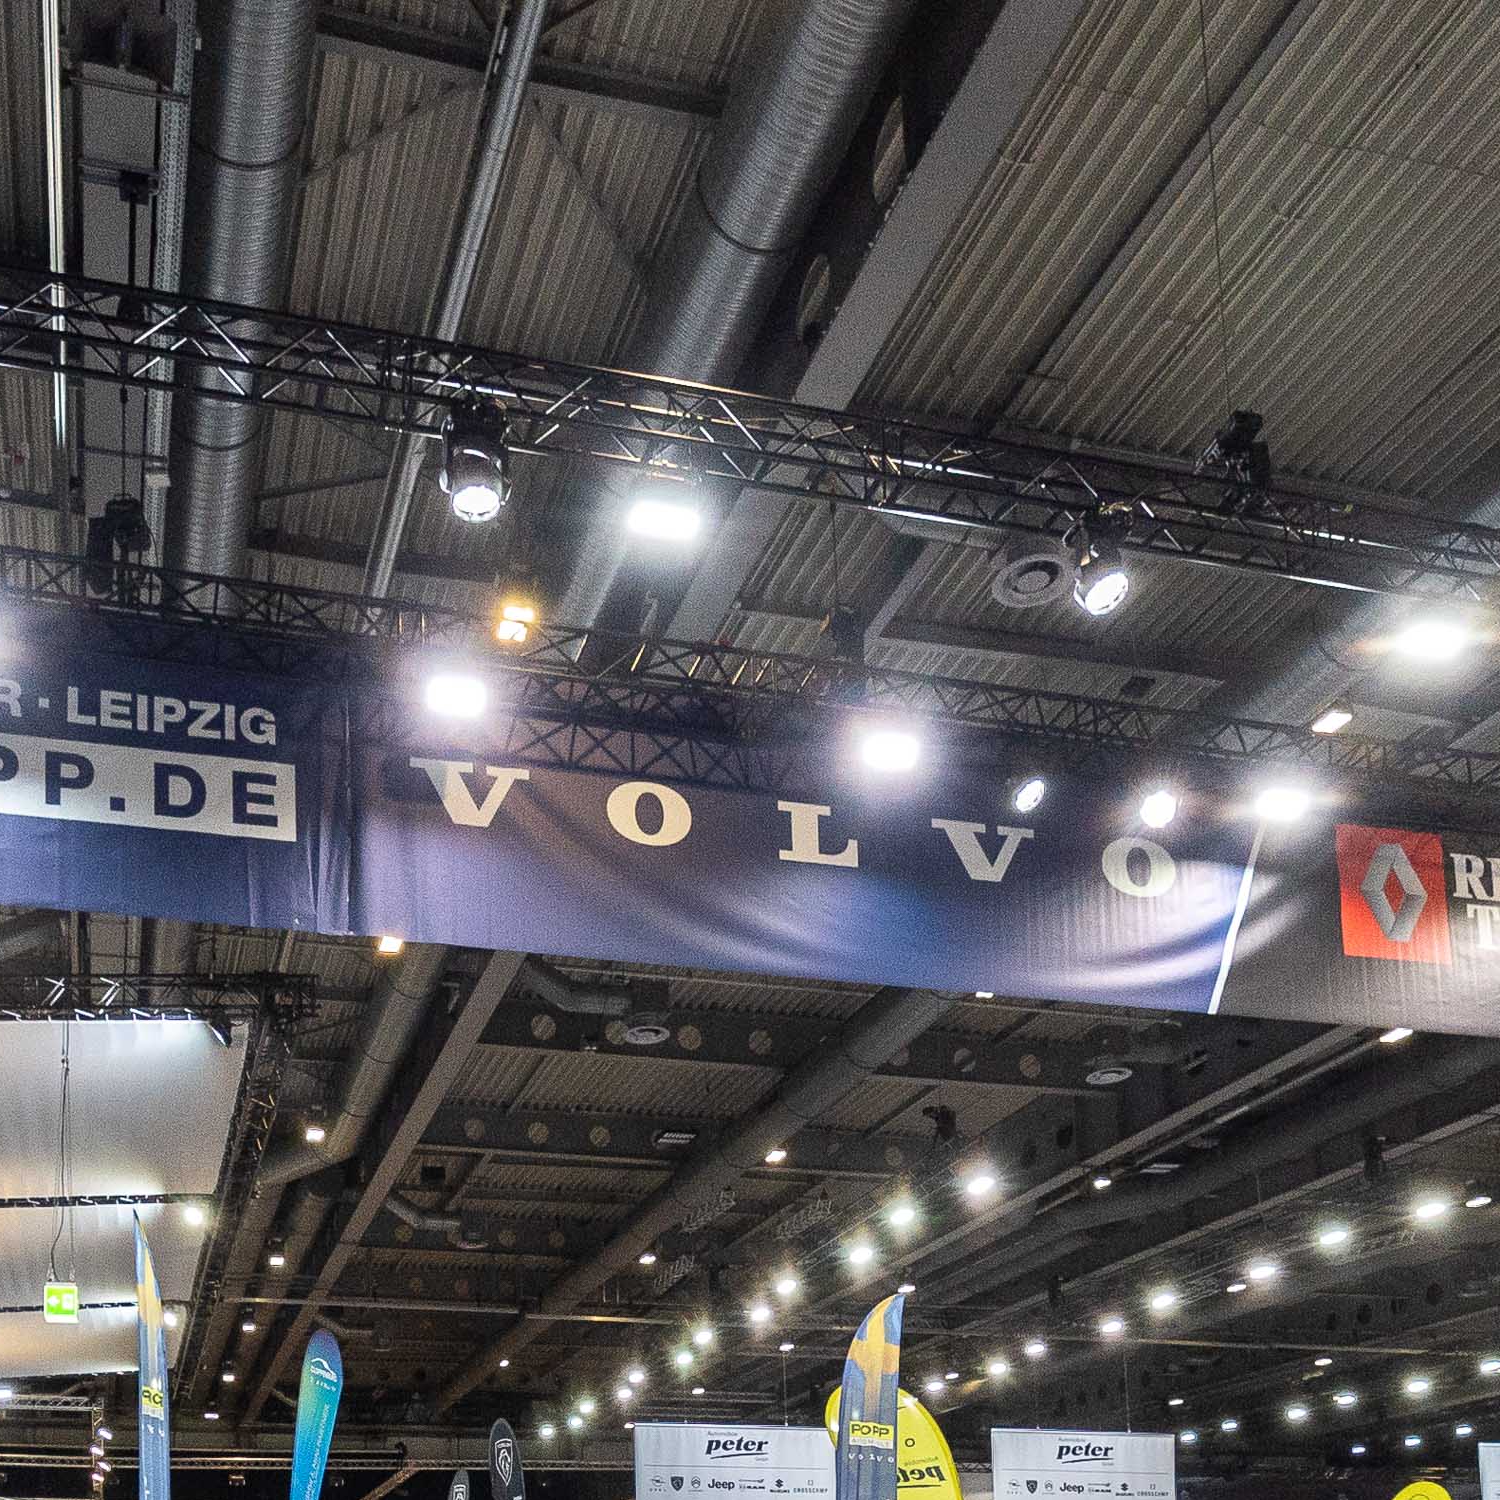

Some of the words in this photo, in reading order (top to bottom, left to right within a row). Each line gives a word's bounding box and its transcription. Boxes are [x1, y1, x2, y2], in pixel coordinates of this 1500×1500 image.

[66, 688, 278, 747] LEIPZIG
[410, 757, 1177, 898] VOLVO
[705, 1436, 769, 1455] peter
[1056, 1443, 1114, 1460] peter
[707, 1479, 735, 1491] Jeep
[1060, 1483, 1085, 1494] Jeep
